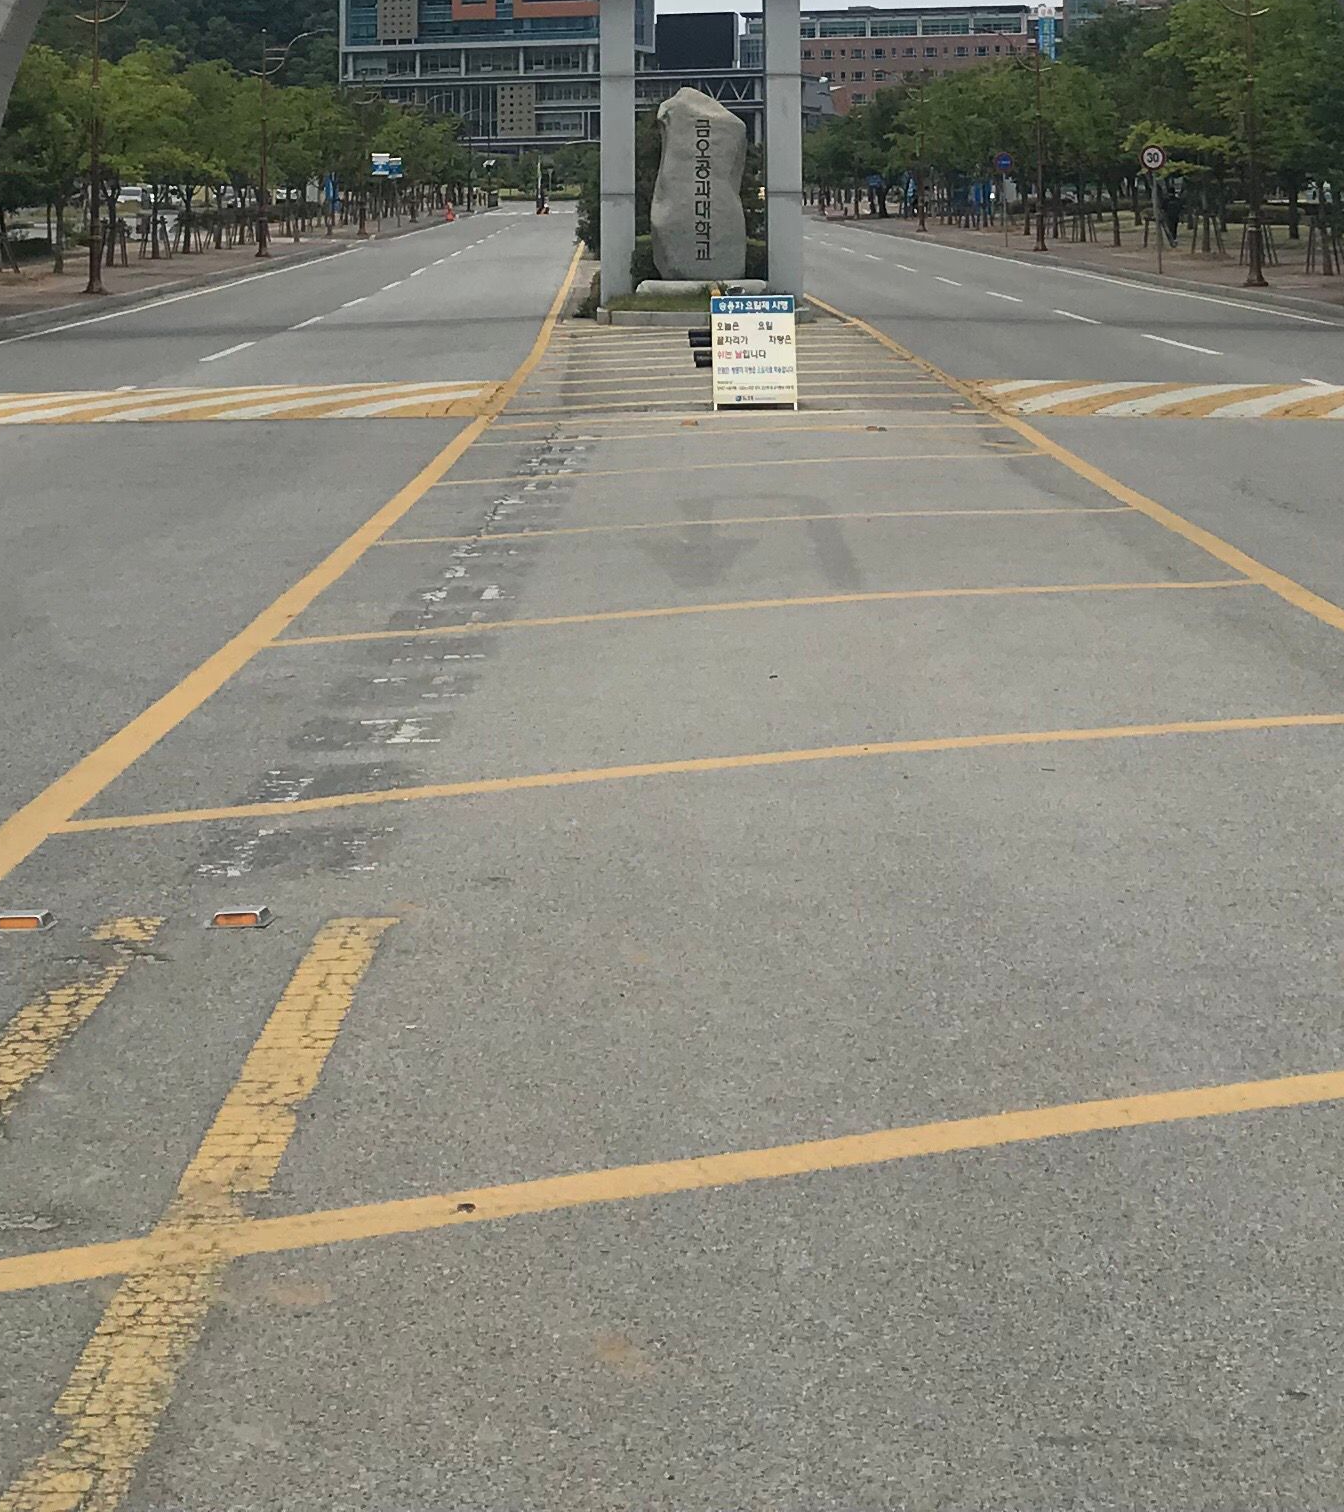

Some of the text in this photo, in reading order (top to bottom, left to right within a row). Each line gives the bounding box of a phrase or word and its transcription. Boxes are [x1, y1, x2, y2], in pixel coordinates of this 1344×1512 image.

[1146, 152, 1159, 163] 30
[694, 119, 712, 261] 금오공과대학교
[717, 321, 773, 331] 오늘은 요일
[769, 335, 791, 345] 차량은
[717, 349, 766, 359] 쉬는 날입니다
